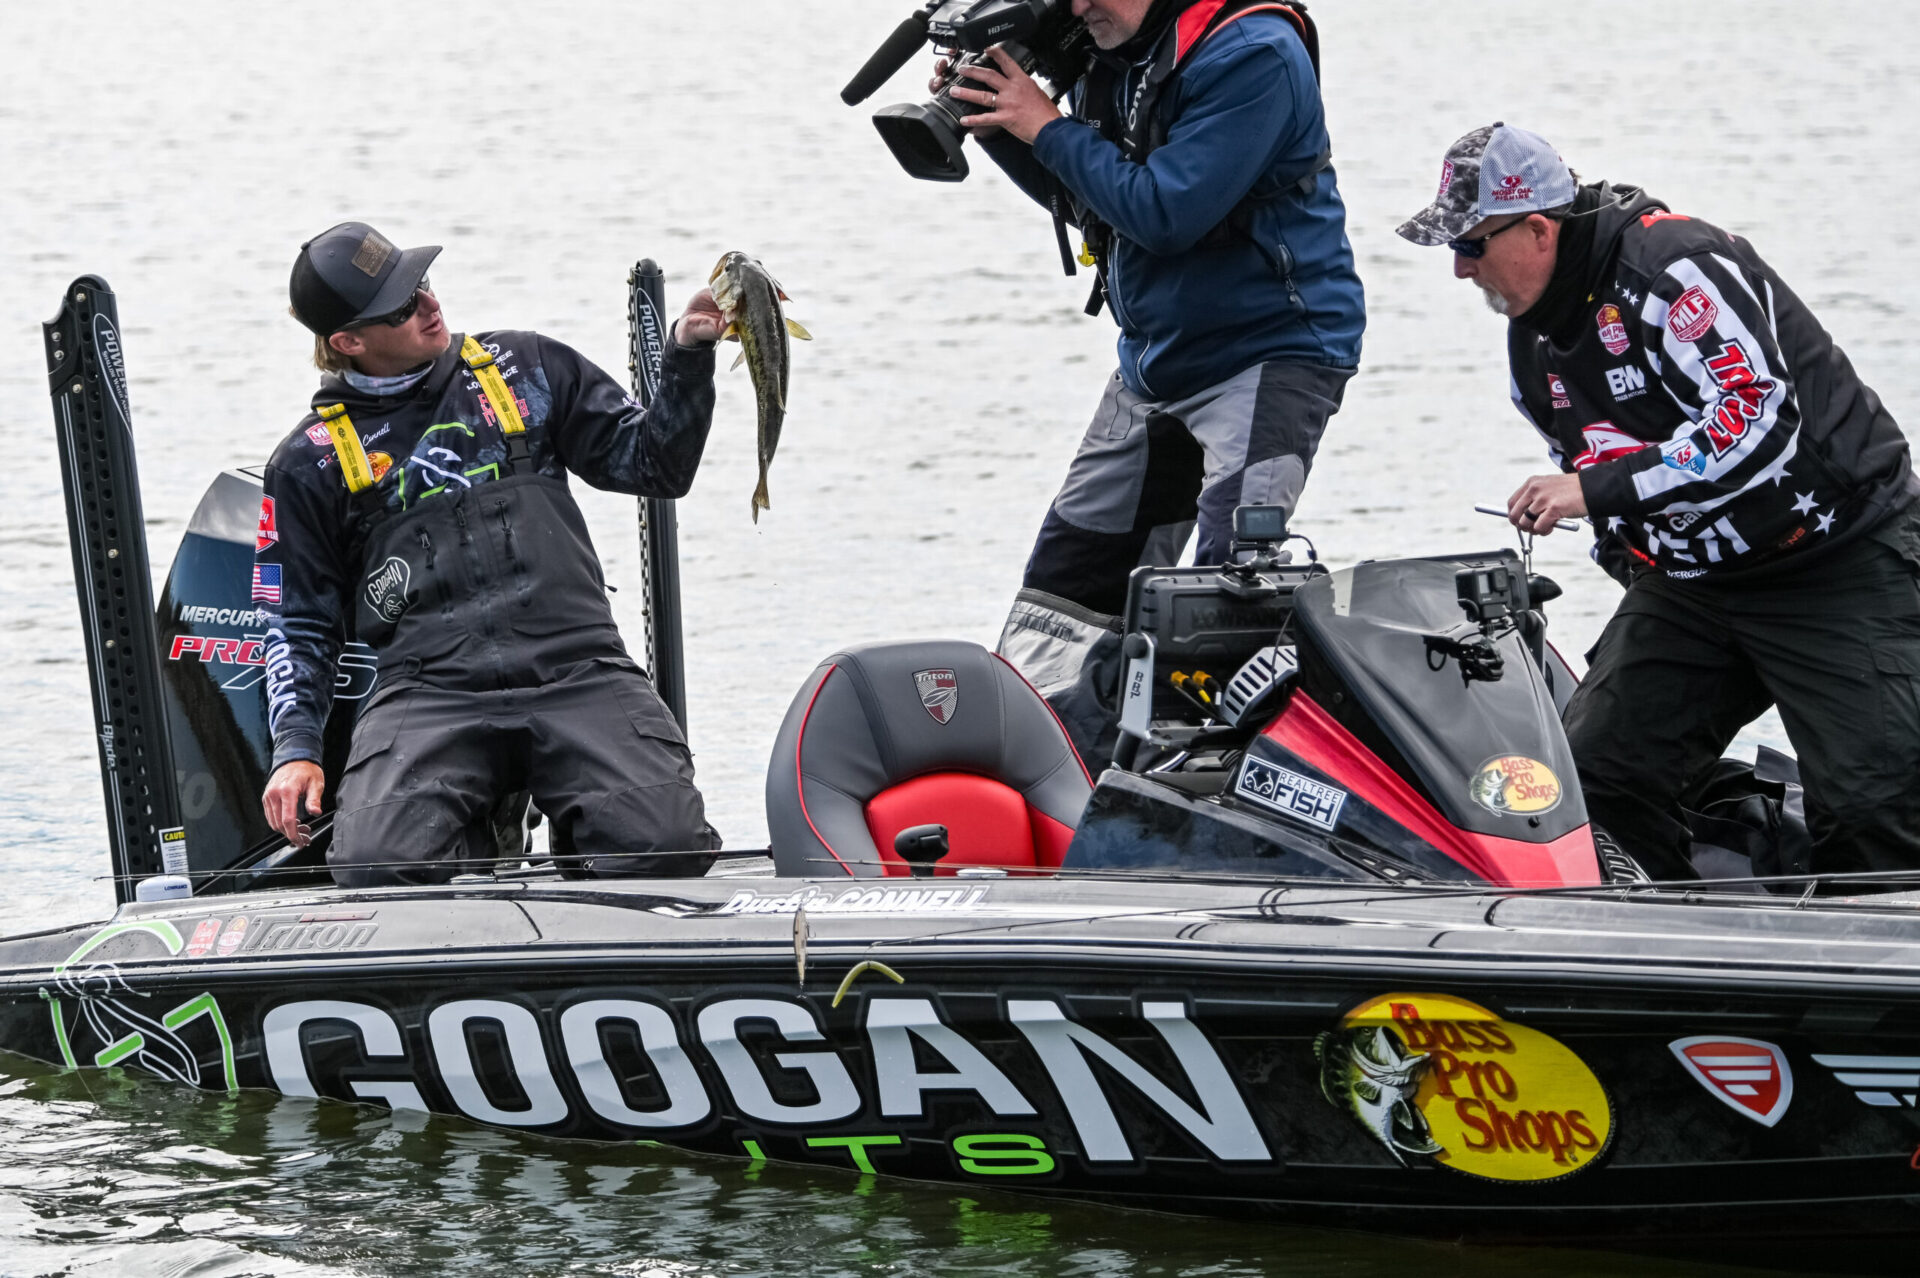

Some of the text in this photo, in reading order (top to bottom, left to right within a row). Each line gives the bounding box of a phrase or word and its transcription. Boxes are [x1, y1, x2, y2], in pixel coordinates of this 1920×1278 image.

[1672, 295, 1708, 333] MLF
[915, 672, 953, 682] Triton
[99, 724, 116, 768] Blade
[1500, 758, 1534, 773] Bass
[1508, 769, 1534, 785] Pro
[1273, 783, 1336, 823] FISH
[1280, 773, 1340, 803] REALTREE
[1515, 783, 1558, 801] Shops
[833, 887, 990, 913] CONNELL
[243, 911, 379, 950] Triton
[1389, 1002, 1516, 1053] Bass
[263, 998, 1273, 1162] GOOGAN
[1430, 1050, 1518, 1101] Pro
[1458, 1097, 1600, 1168] Shops
